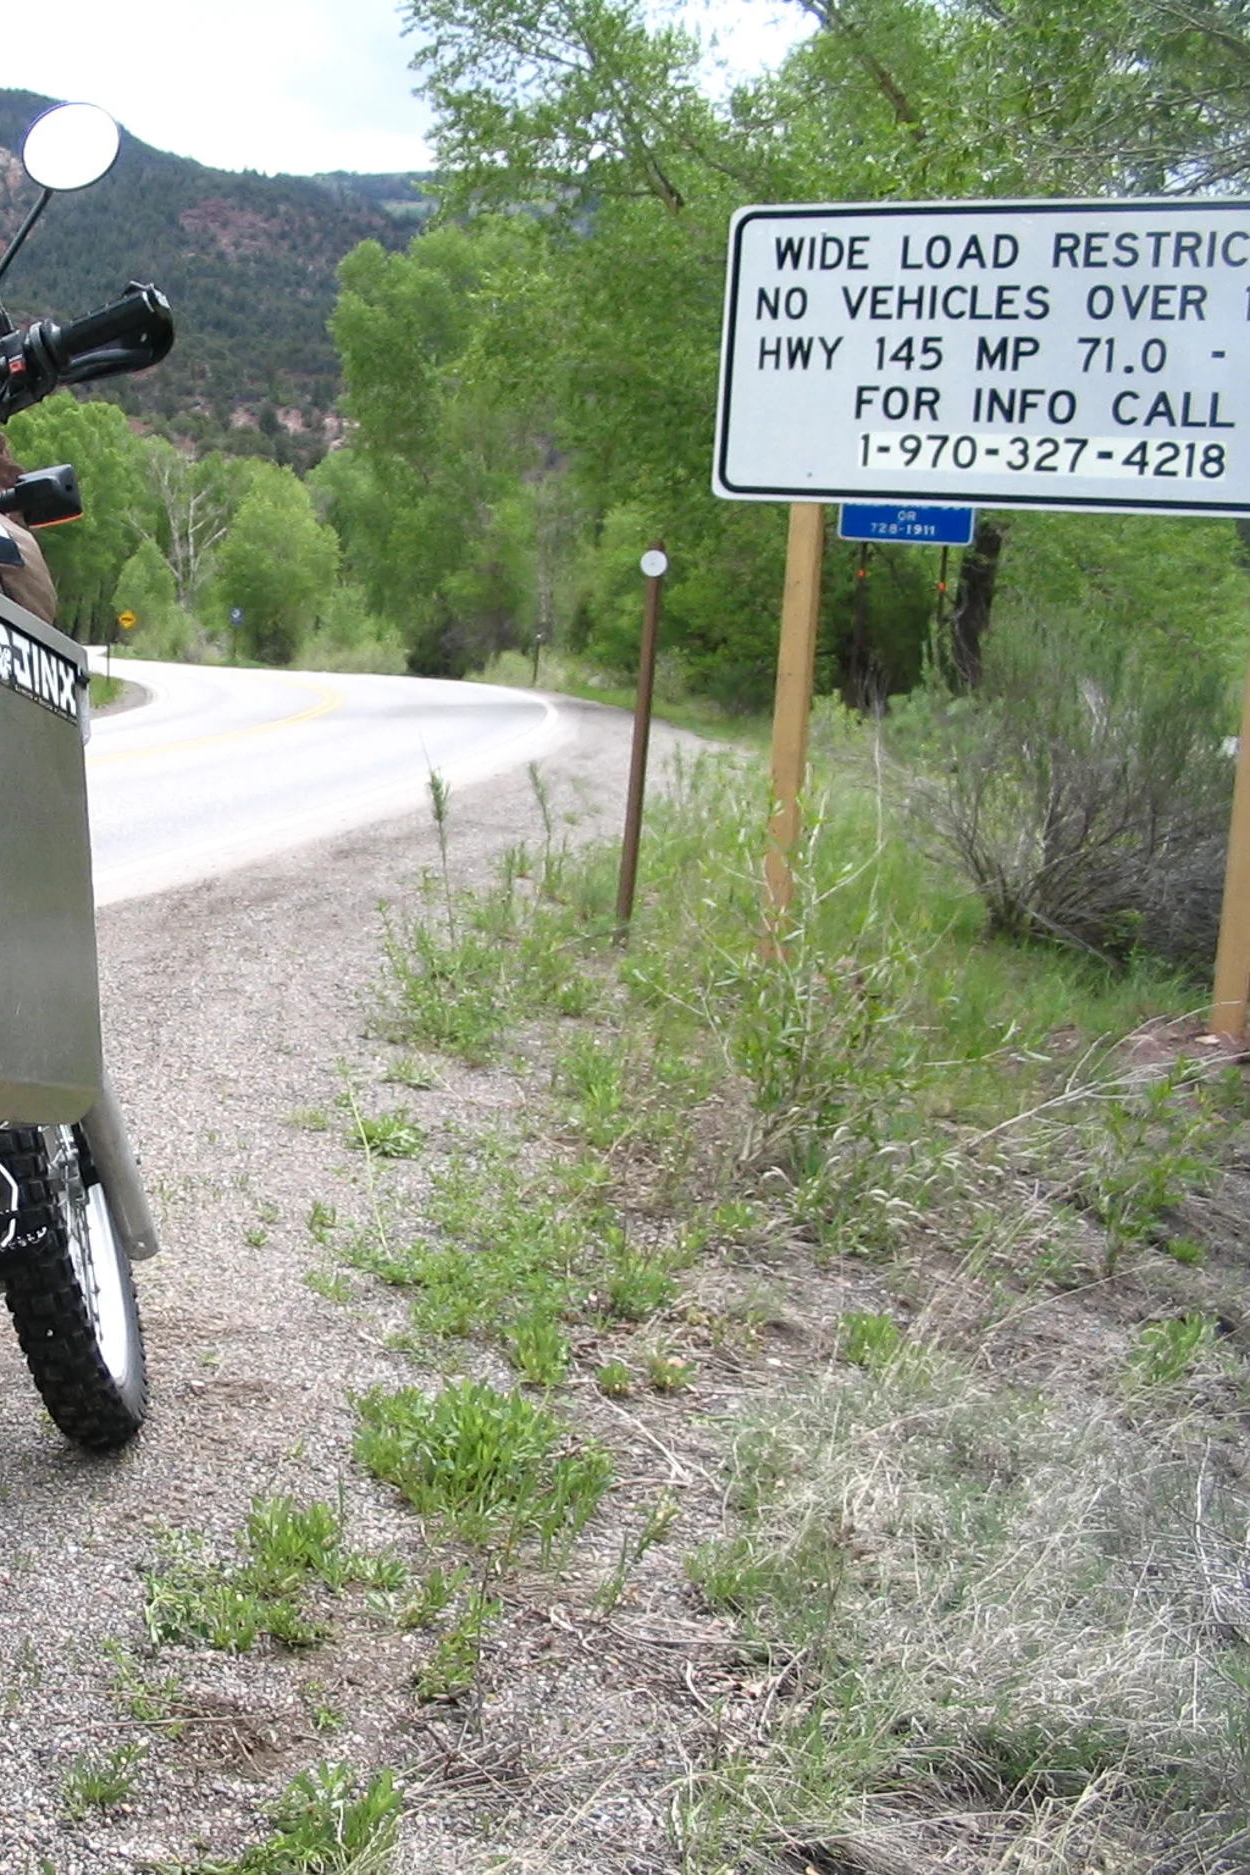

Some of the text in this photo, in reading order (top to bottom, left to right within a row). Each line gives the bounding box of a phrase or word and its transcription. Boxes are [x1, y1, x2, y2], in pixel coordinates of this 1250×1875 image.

[775, 230, 1250, 271] WIDE LOAD RESTRIC
[756, 286, 808, 321] NO
[842, 285, 1050, 321] VEHICLES
[1086, 284, 1208, 321] OVER
[758, 336, 843, 370] HWY
[876, 336, 943, 371] 145
[976, 336, 1040, 372] MP
[1077, 337, 1167, 374] 71.0
[855, 385, 1235, 428] FOR INFO CALL
[861, 434, 1225, 479] 1-970-327-4218
[897, 510, 917, 521] OR
[11, 630, 78, 717] JINX
